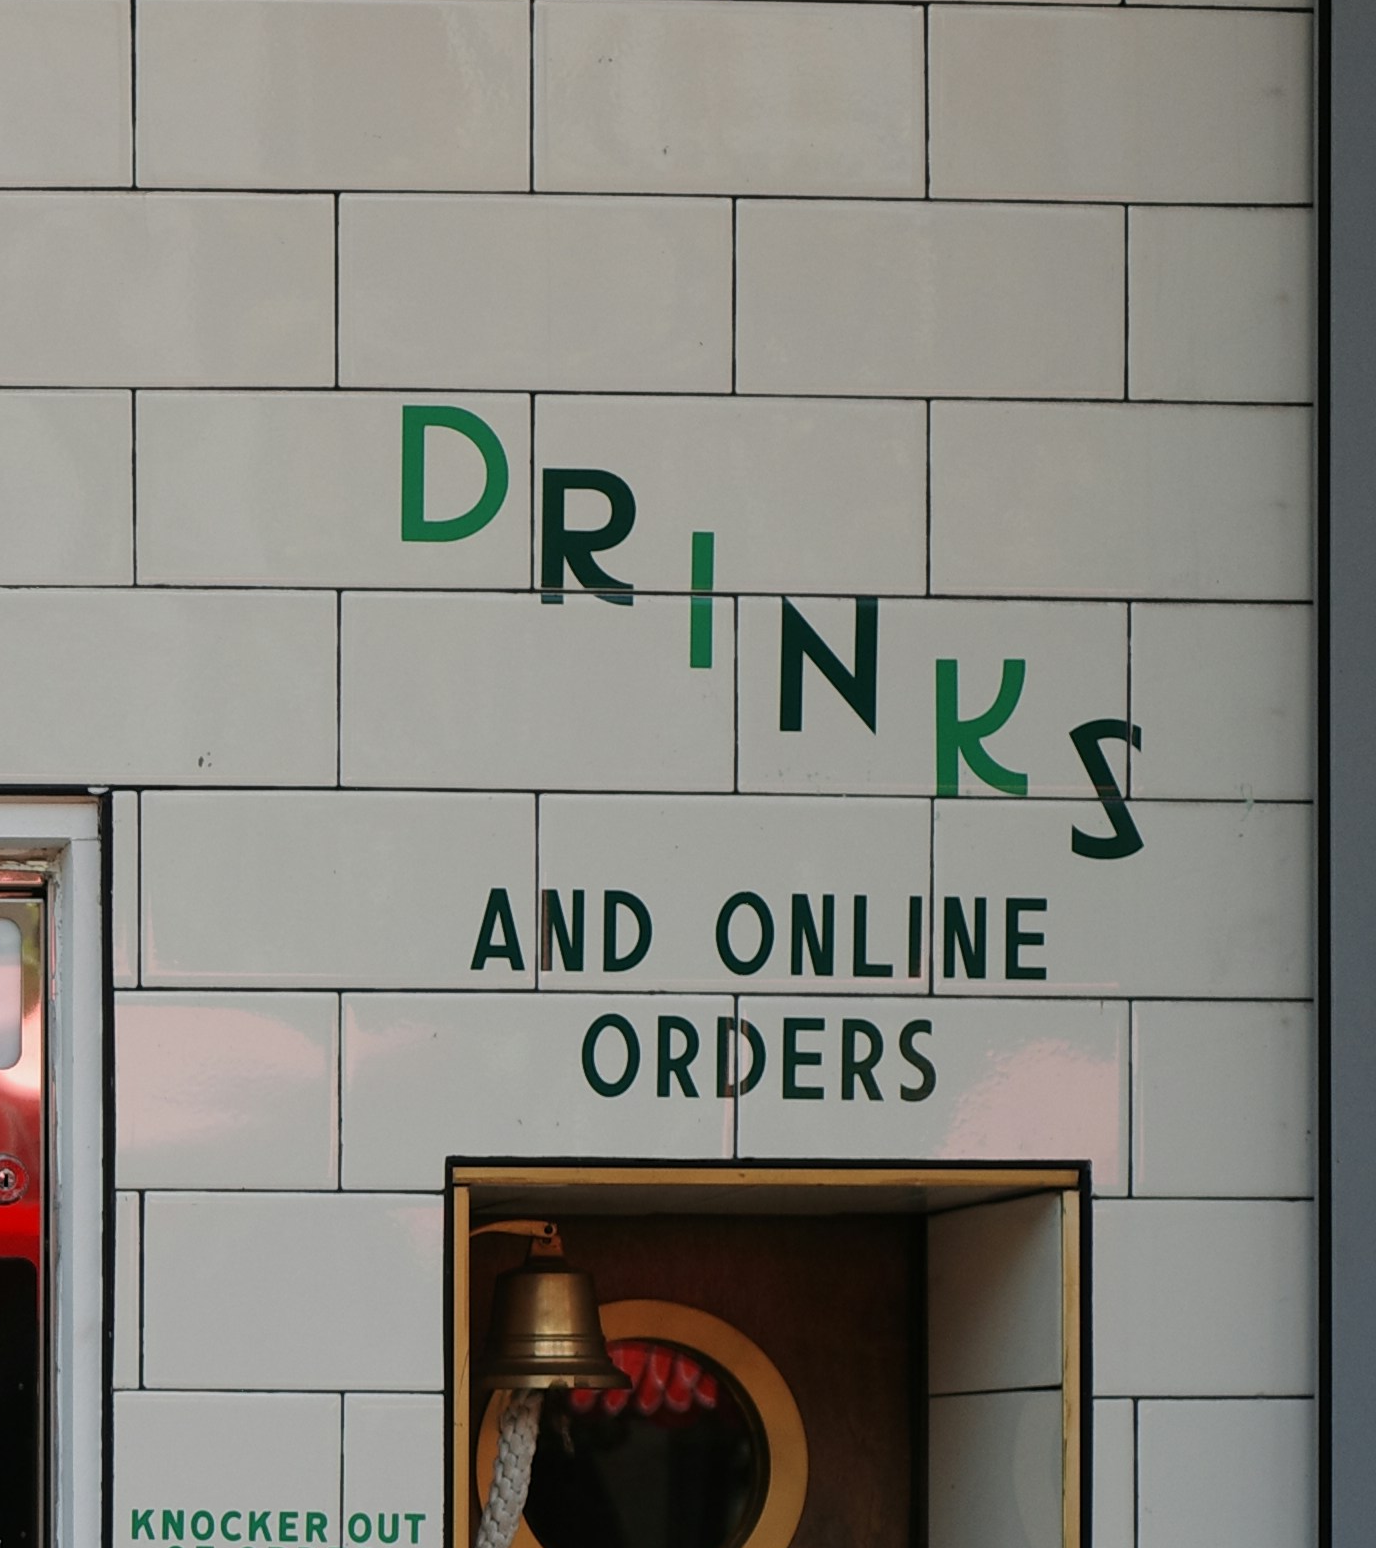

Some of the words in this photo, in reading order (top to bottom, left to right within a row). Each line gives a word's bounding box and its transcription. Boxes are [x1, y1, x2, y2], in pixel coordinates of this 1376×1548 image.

[401, 404, 1144, 860] DRINKS
[471, 889, 652, 972] AND
[717, 892, 1048, 980] ONLINE
[582, 1013, 937, 1103] ORDERS
[130, 1508, 328, 1545] KNOCKER
[348, 1511, 427, 1547] OUT
